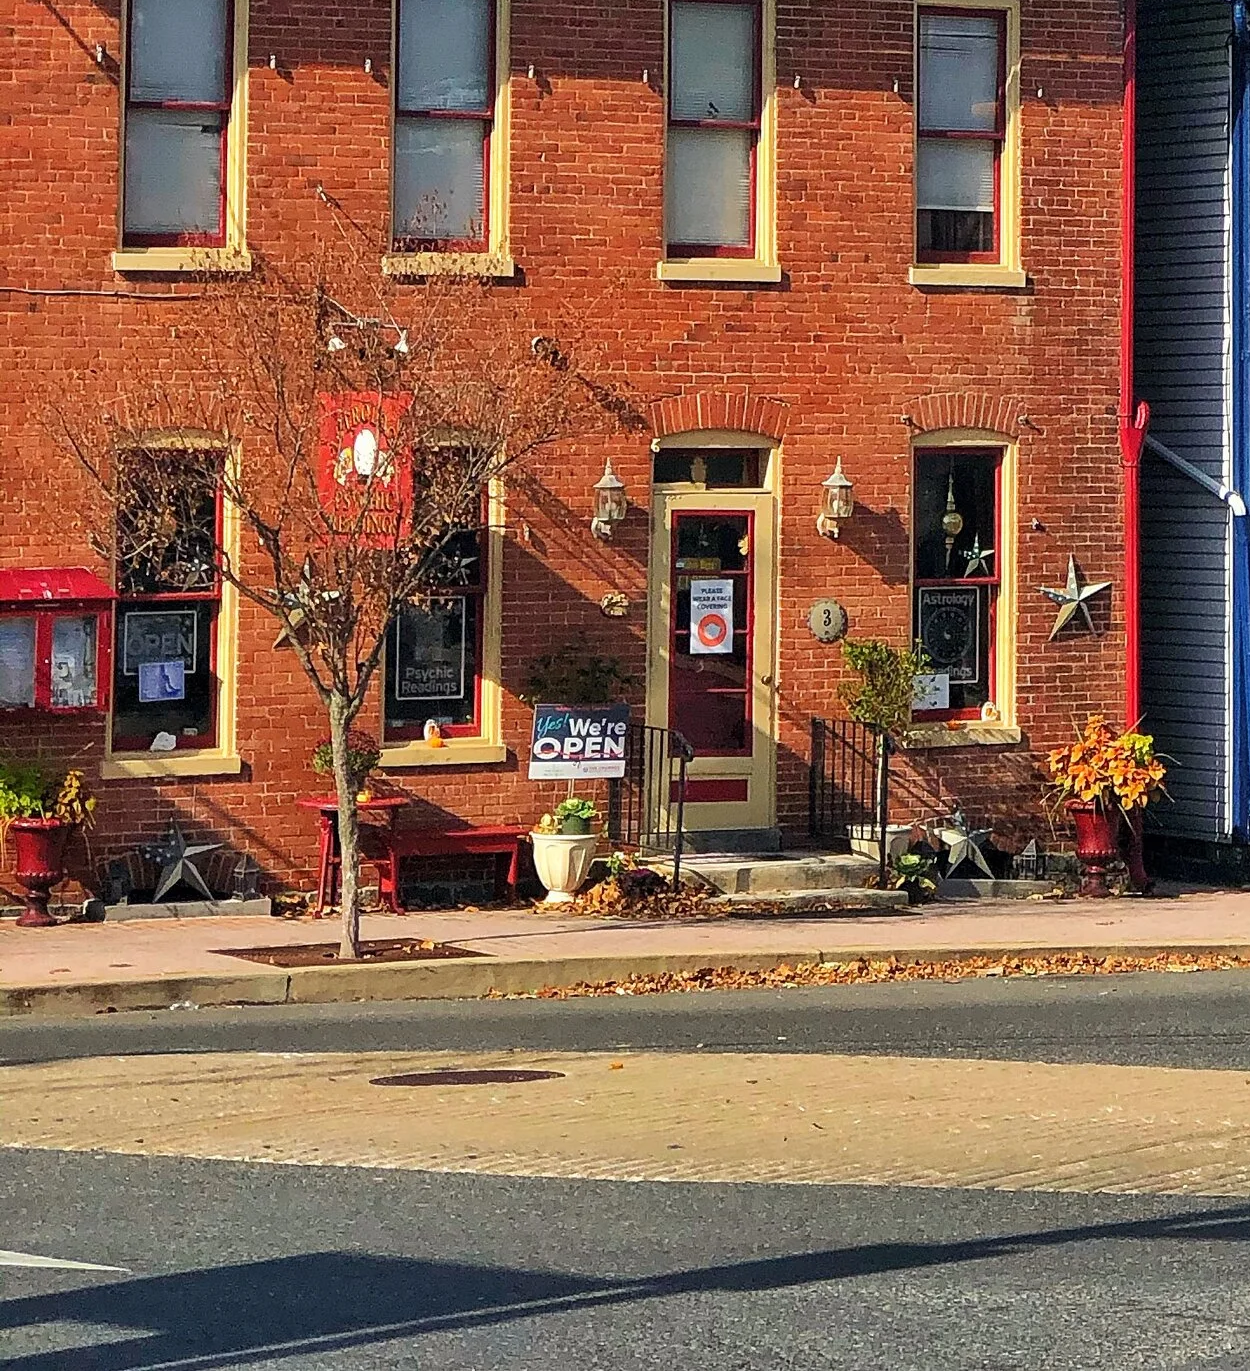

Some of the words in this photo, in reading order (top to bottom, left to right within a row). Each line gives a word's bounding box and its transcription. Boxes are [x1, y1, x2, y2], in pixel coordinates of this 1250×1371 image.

[923, 592, 975, 607] Astrology
[823, 609, 831, 627] 3
[127, 633, 193, 656] OPEN
[405, 666, 454, 682] Psychic
[401, 680, 458, 695] Readings
[537, 712, 570, 739] Yes!
[568, 718, 626, 737] We're
[533, 736, 625, 760] OPEN
